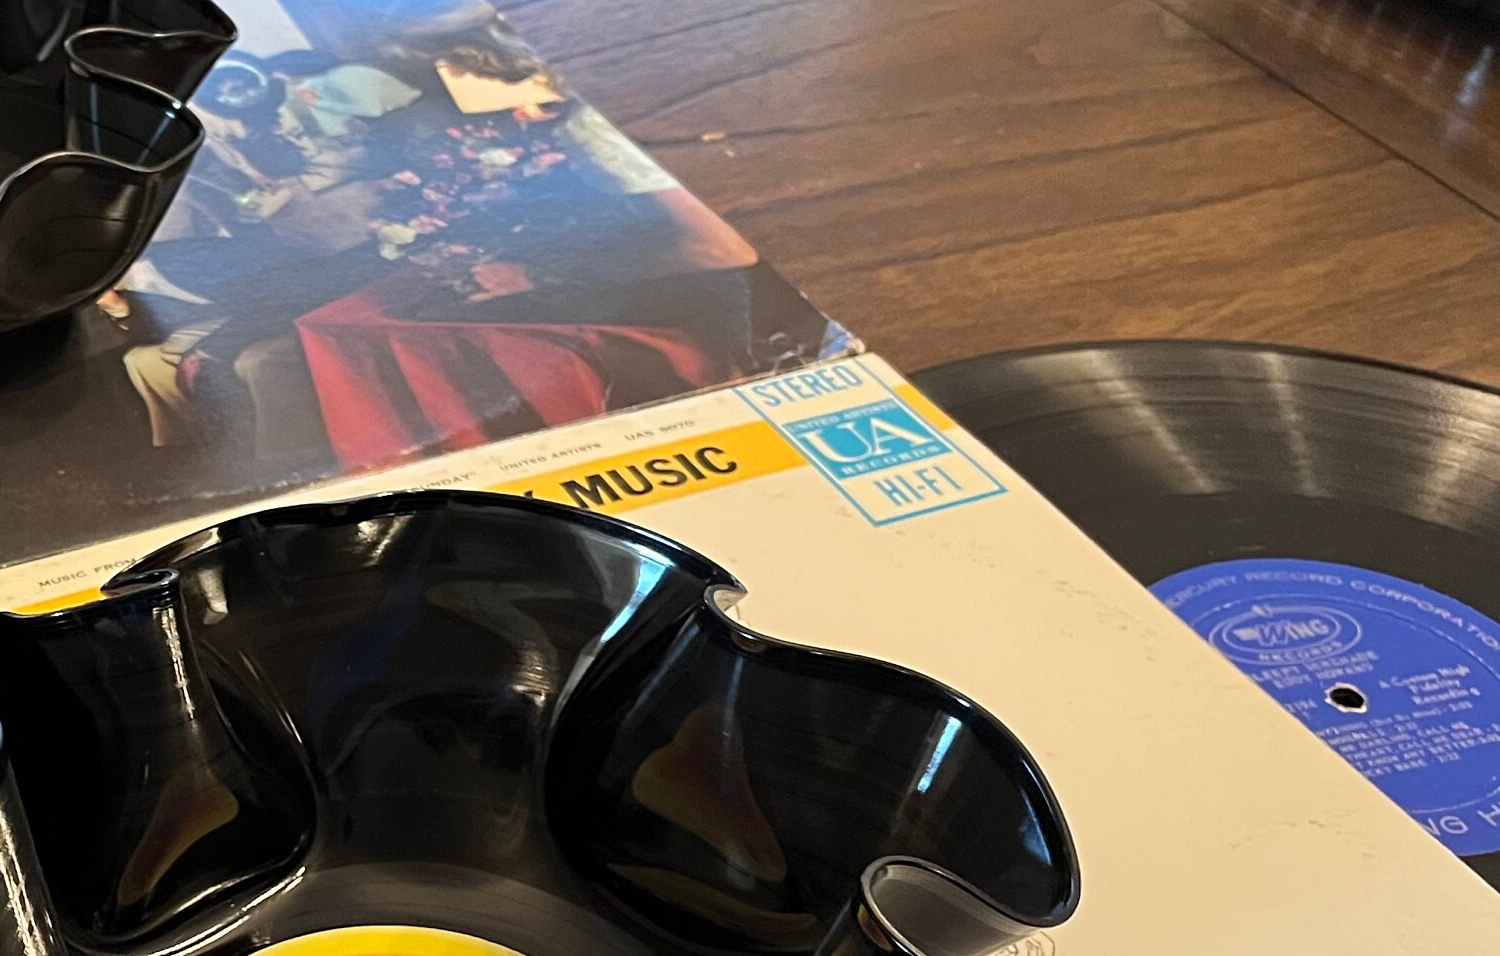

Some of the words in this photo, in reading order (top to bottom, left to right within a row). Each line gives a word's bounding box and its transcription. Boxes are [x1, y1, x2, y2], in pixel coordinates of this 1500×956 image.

[751, 364, 864, 408] STEREO
[786, 416, 840, 432] UNITED
[802, 416, 936, 463] UA
[499, 456, 548, 472] UNITED
[551, 442, 601, 459] ARTISTS
[840, 445, 942, 476] RECORDS
[560, 447, 738, 510] MUSIC
[873, 465, 963, 507] HI-FI
[38, 571, 87, 588] MUSIC
[1257, 618, 1329, 647] WING
